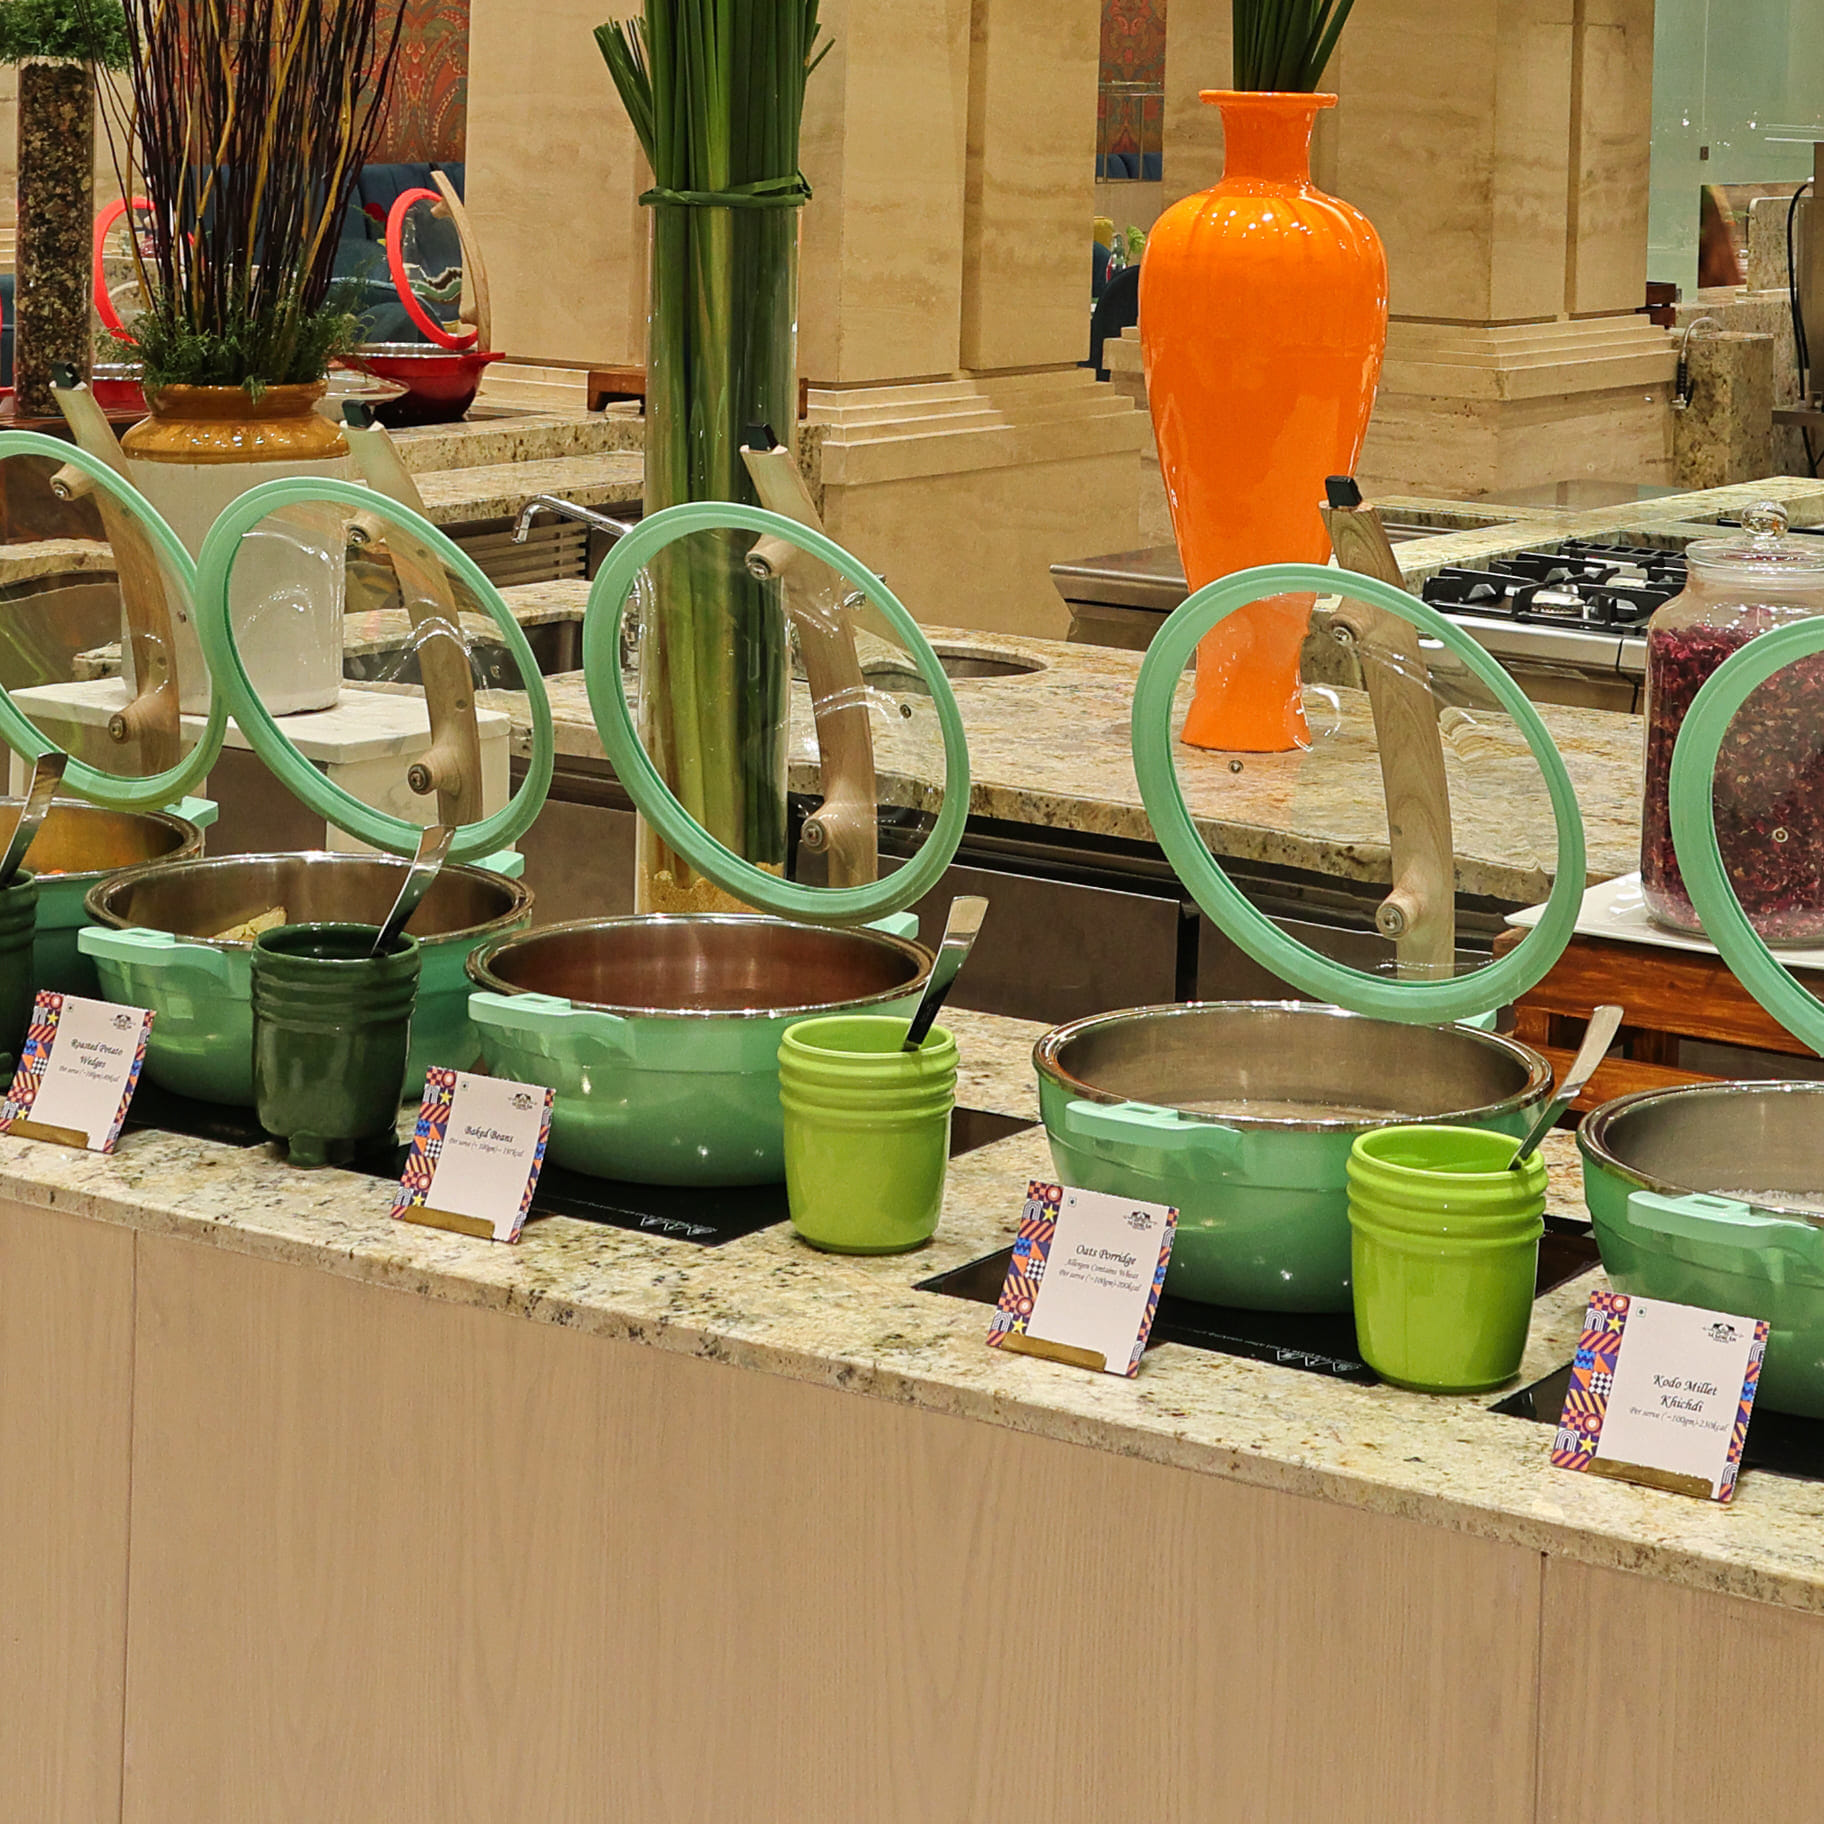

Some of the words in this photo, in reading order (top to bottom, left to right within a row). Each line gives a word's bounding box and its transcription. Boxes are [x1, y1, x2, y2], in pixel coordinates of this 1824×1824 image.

[464, 1125, 492, 1139] Baked
[490, 1130, 514, 1143] Beans
[1075, 1244, 1098, 1257] Oats
[1098, 1249, 1137, 1268] Porridge
[1652, 1374, 1682, 1389] Kodo
[1683, 1380, 1718, 1396] Millet
[1660, 1394, 1705, 1413] Khichdi
